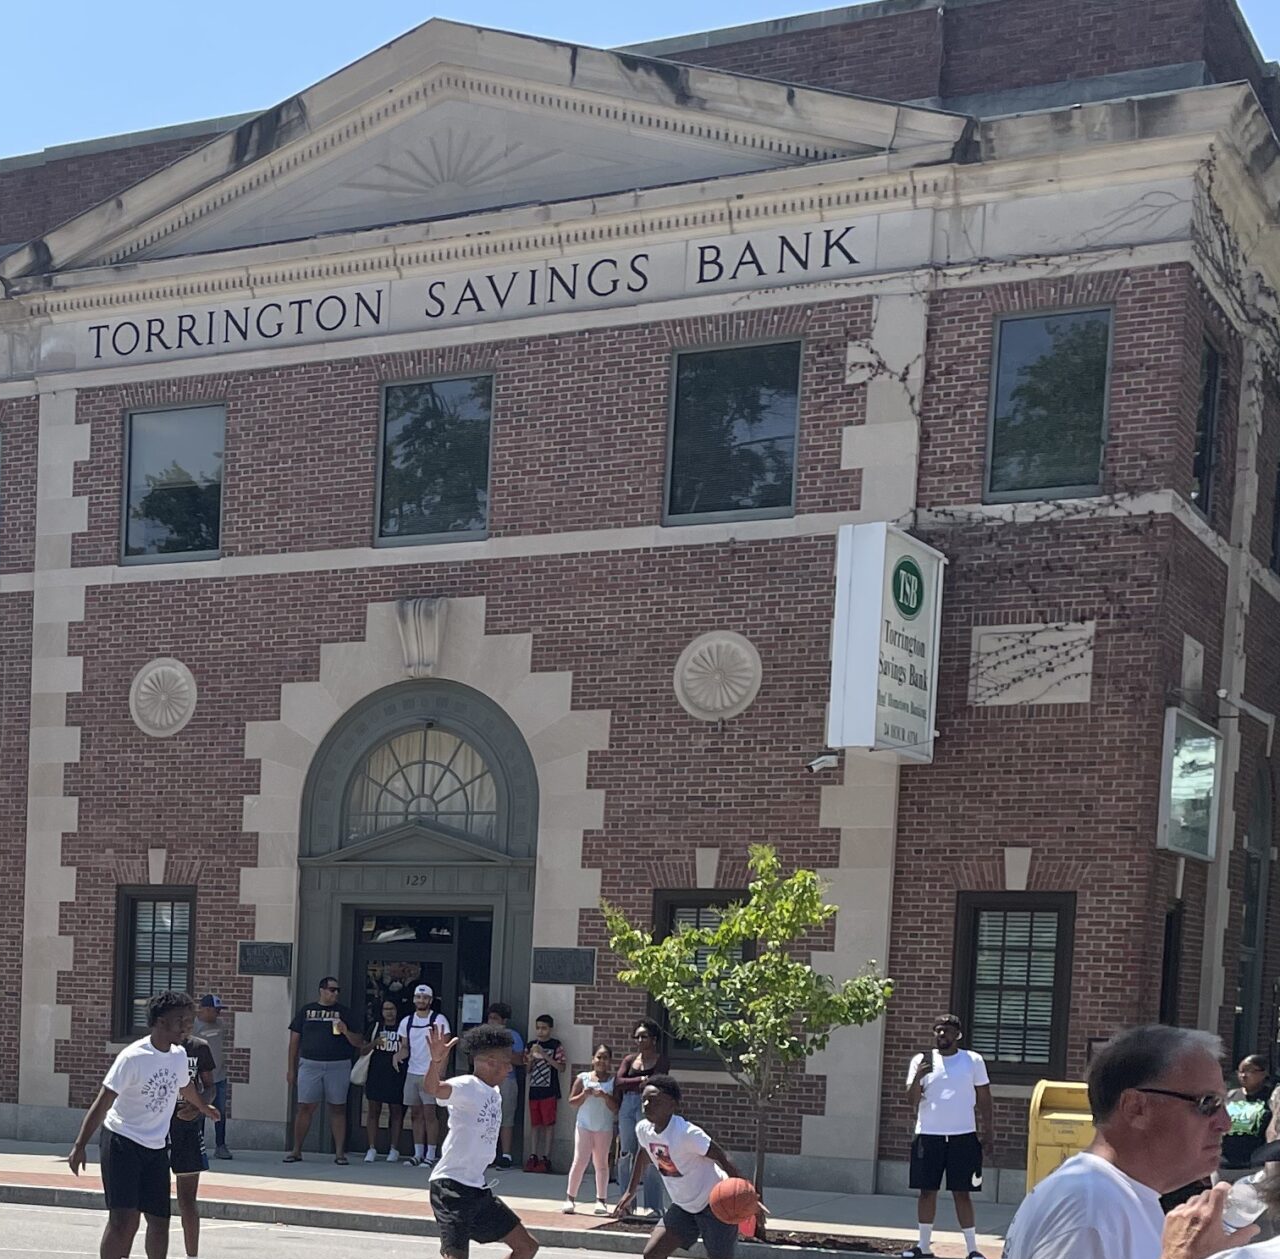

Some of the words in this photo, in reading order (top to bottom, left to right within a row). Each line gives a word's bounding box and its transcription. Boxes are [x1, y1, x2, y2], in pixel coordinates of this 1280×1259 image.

[88, 289, 384, 359] TORRINGTON
[424, 253, 650, 318] SAVINGS
[696, 226, 860, 284] BANK
[898, 568, 918, 609] TSB
[884, 619, 926, 658] Torrington
[878, 651, 907, 686] Savings
[909, 663, 928, 691] Bank
[405, 874, 428, 887] 129
